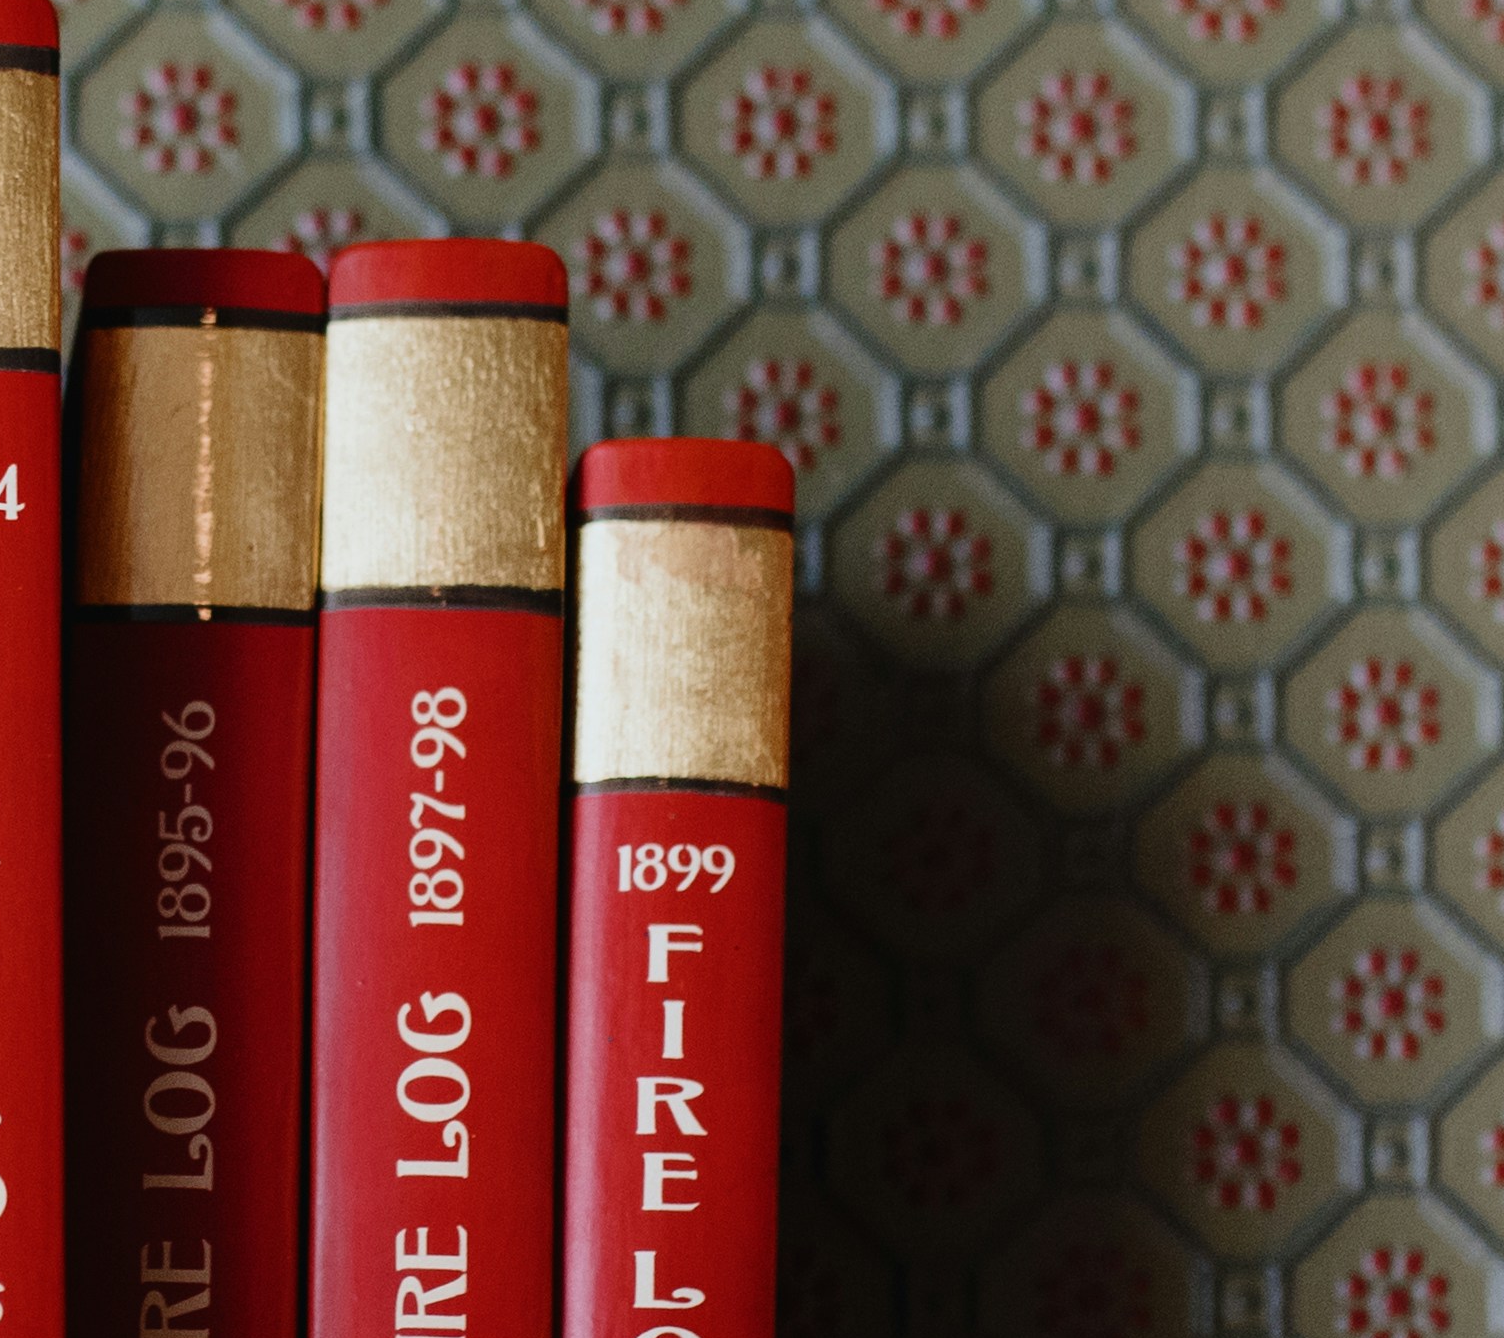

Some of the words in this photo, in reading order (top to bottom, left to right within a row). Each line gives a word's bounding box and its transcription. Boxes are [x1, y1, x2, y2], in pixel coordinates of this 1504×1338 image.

[156, 699, 217, 940] 1895-96
[408, 686, 468, 928] 1897-98
[616, 842, 736, 893] 1899
[143, 1004, 218, 1192] LOG
[395, 991, 472, 1179] LOG
[635, 923, 707, 1212] FIRE
